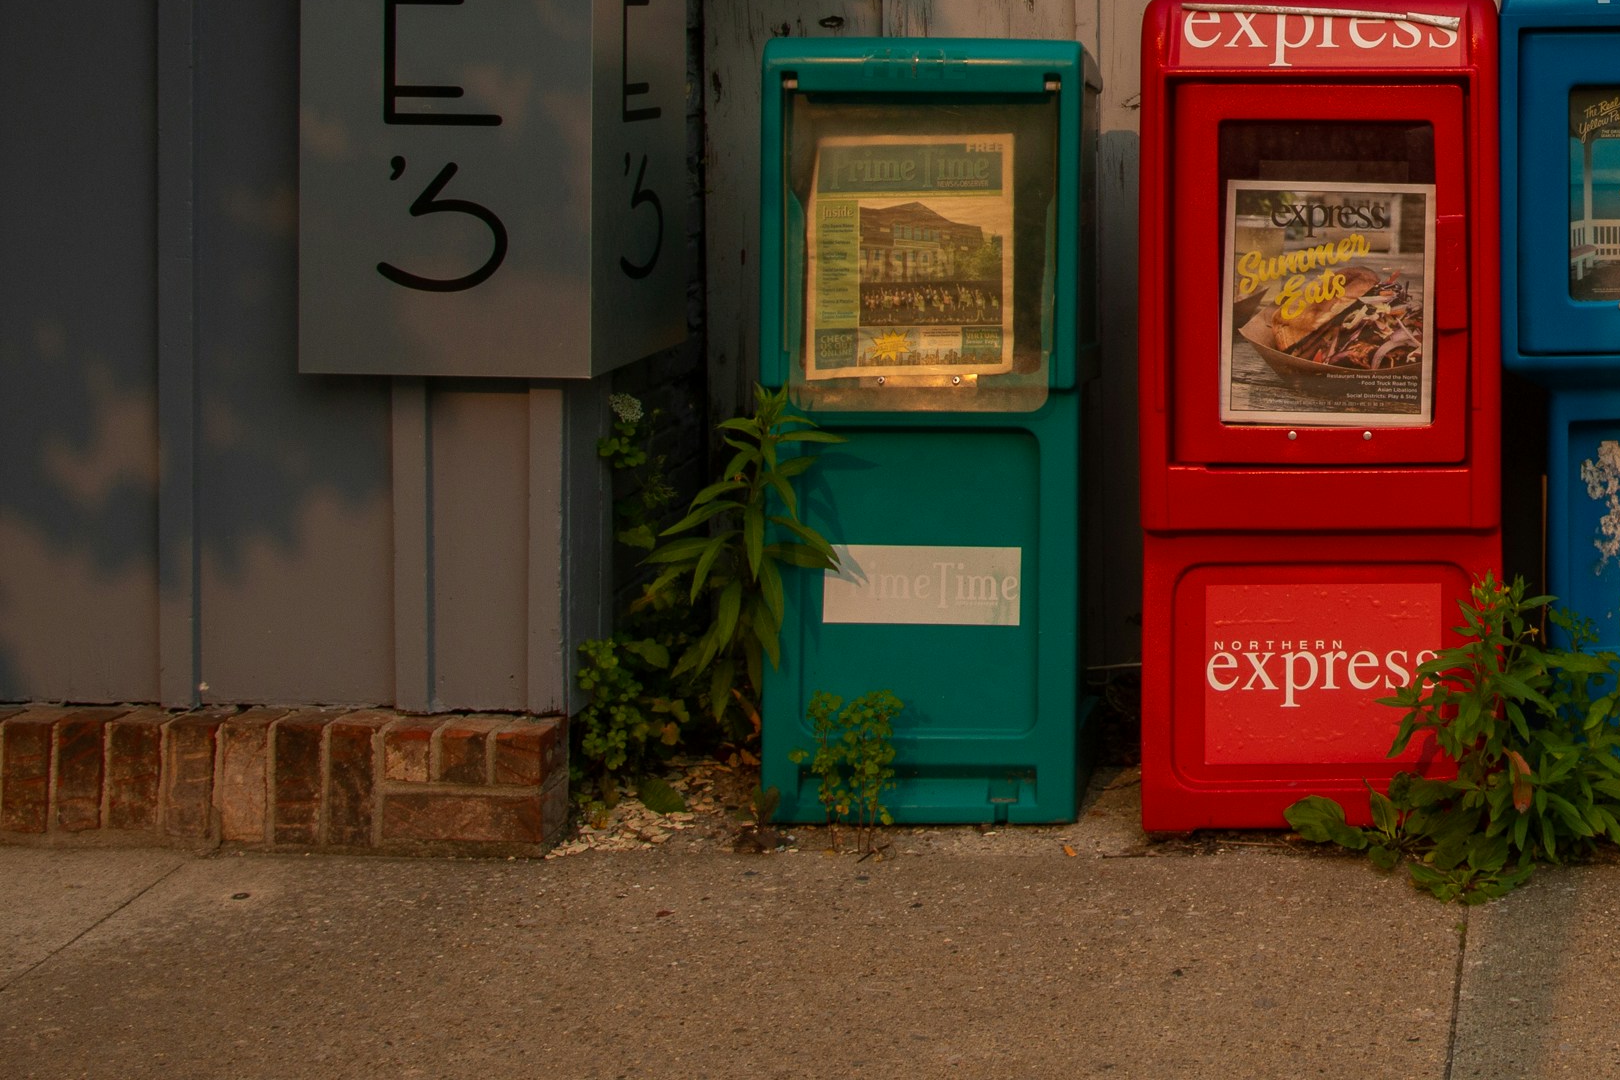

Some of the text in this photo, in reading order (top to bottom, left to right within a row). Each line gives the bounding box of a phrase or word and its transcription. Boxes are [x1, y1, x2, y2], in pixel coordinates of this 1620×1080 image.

[1184, 6, 1459, 67] express
[1579, 117, 1609, 144] Yellow
[967, 142, 1003, 153] FREE
[830, 148, 990, 190] Prime Time
[822, 206, 854, 220] Inside
[1272, 204, 1386, 237] express
[1238, 233, 1370, 294] Summer
[1275, 268, 1346, 320] Eats
[820, 334, 852, 343] CHECK
[820, 349, 852, 358] ONLINE
[933, 562, 1018, 608] Time
[1214, 640, 1342, 650] NORTHERN
[1206, 649, 1442, 708] express
